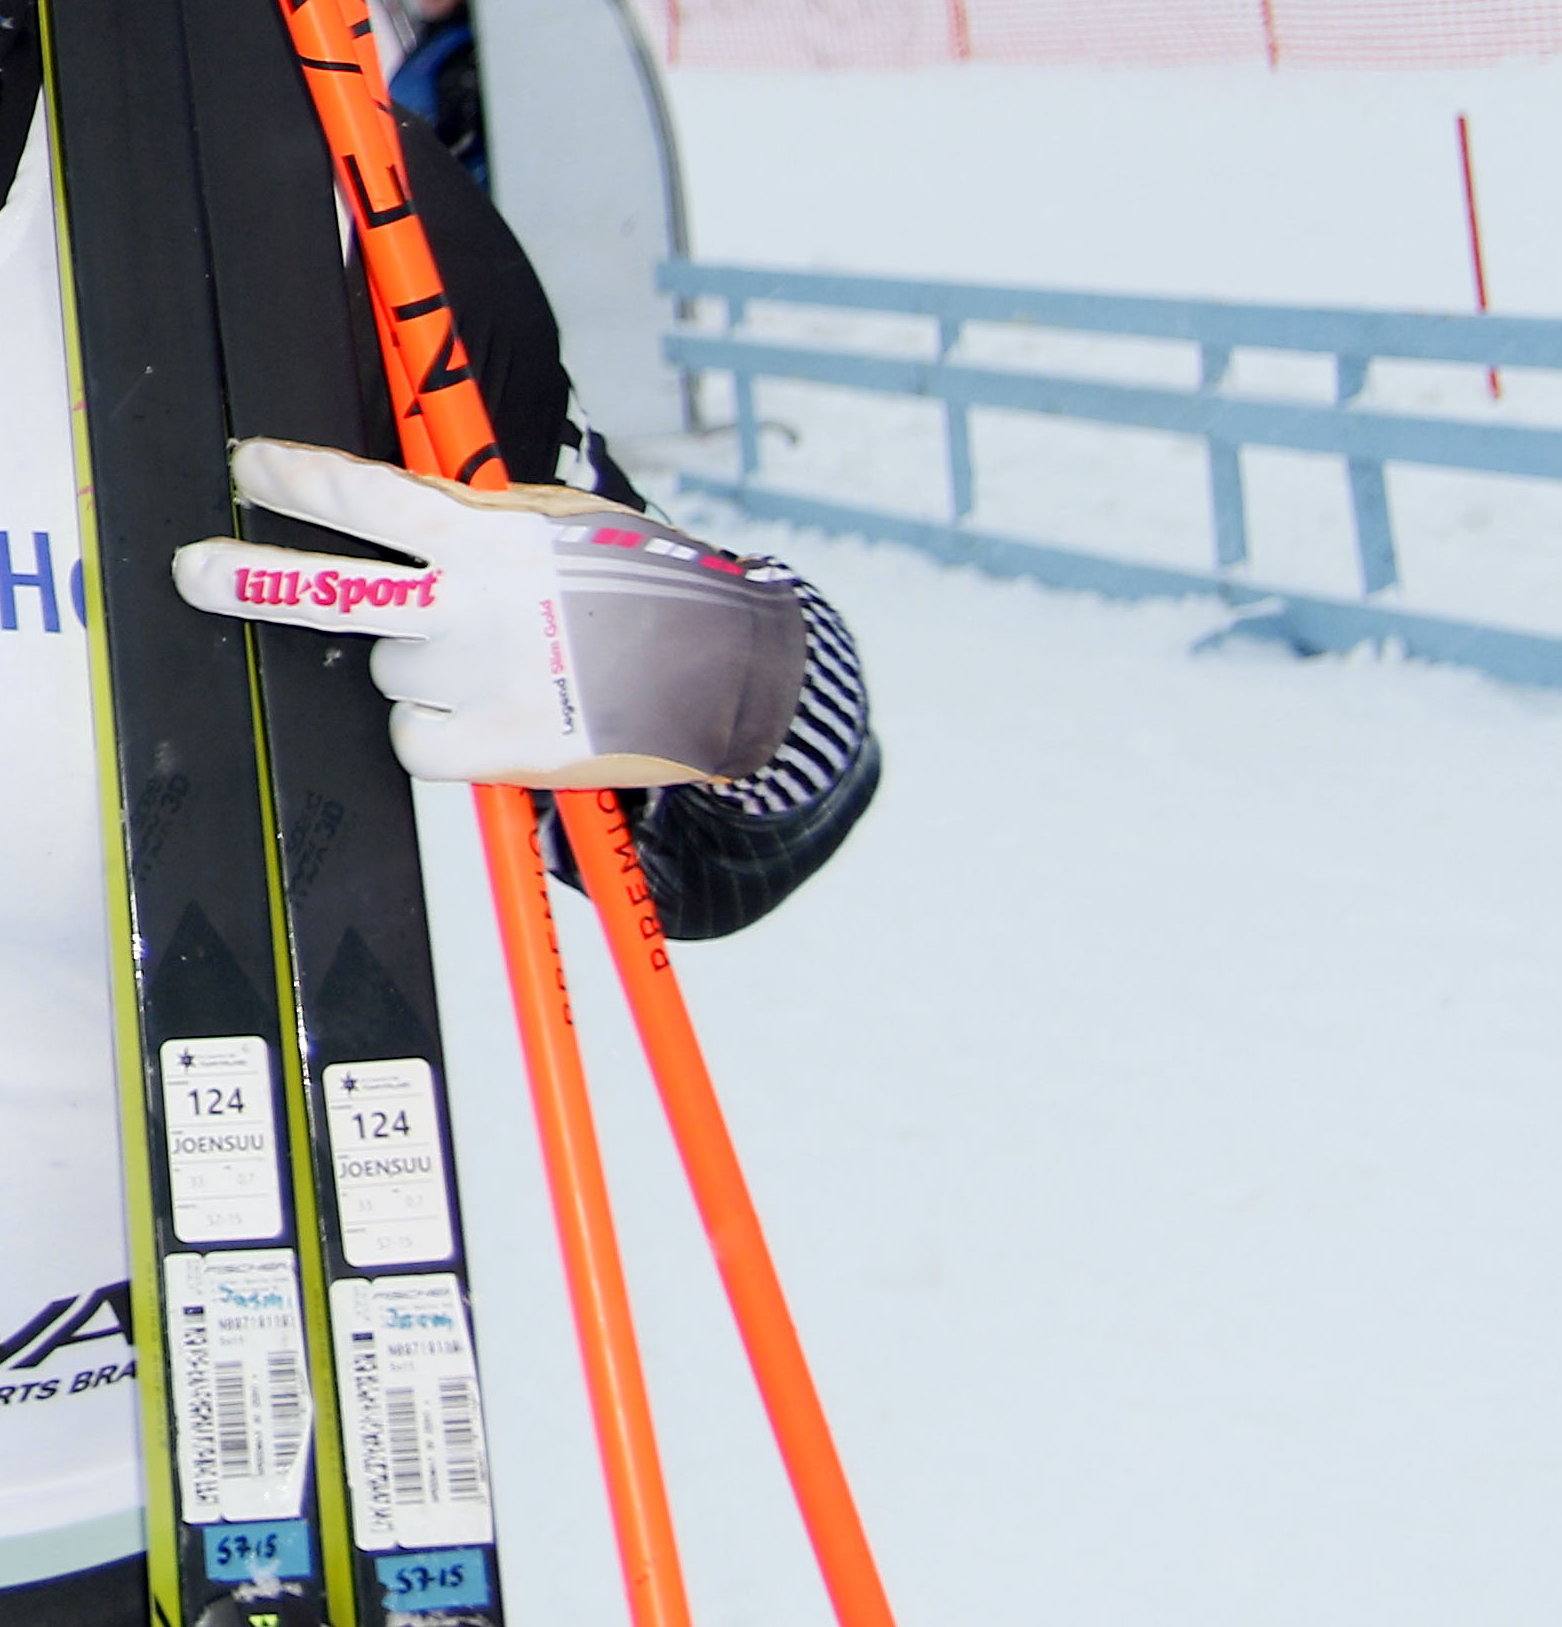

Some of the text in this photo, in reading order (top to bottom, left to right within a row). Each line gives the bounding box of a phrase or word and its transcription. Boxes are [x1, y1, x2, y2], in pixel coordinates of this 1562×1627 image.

[188, 1087, 246, 1116] 124
[352, 1109, 412, 1140] 124
[171, 1134, 265, 1156] JOENSUU
[339, 1156, 432, 1179] JOENSUU
[69, 1360, 138, 1394] BRA
